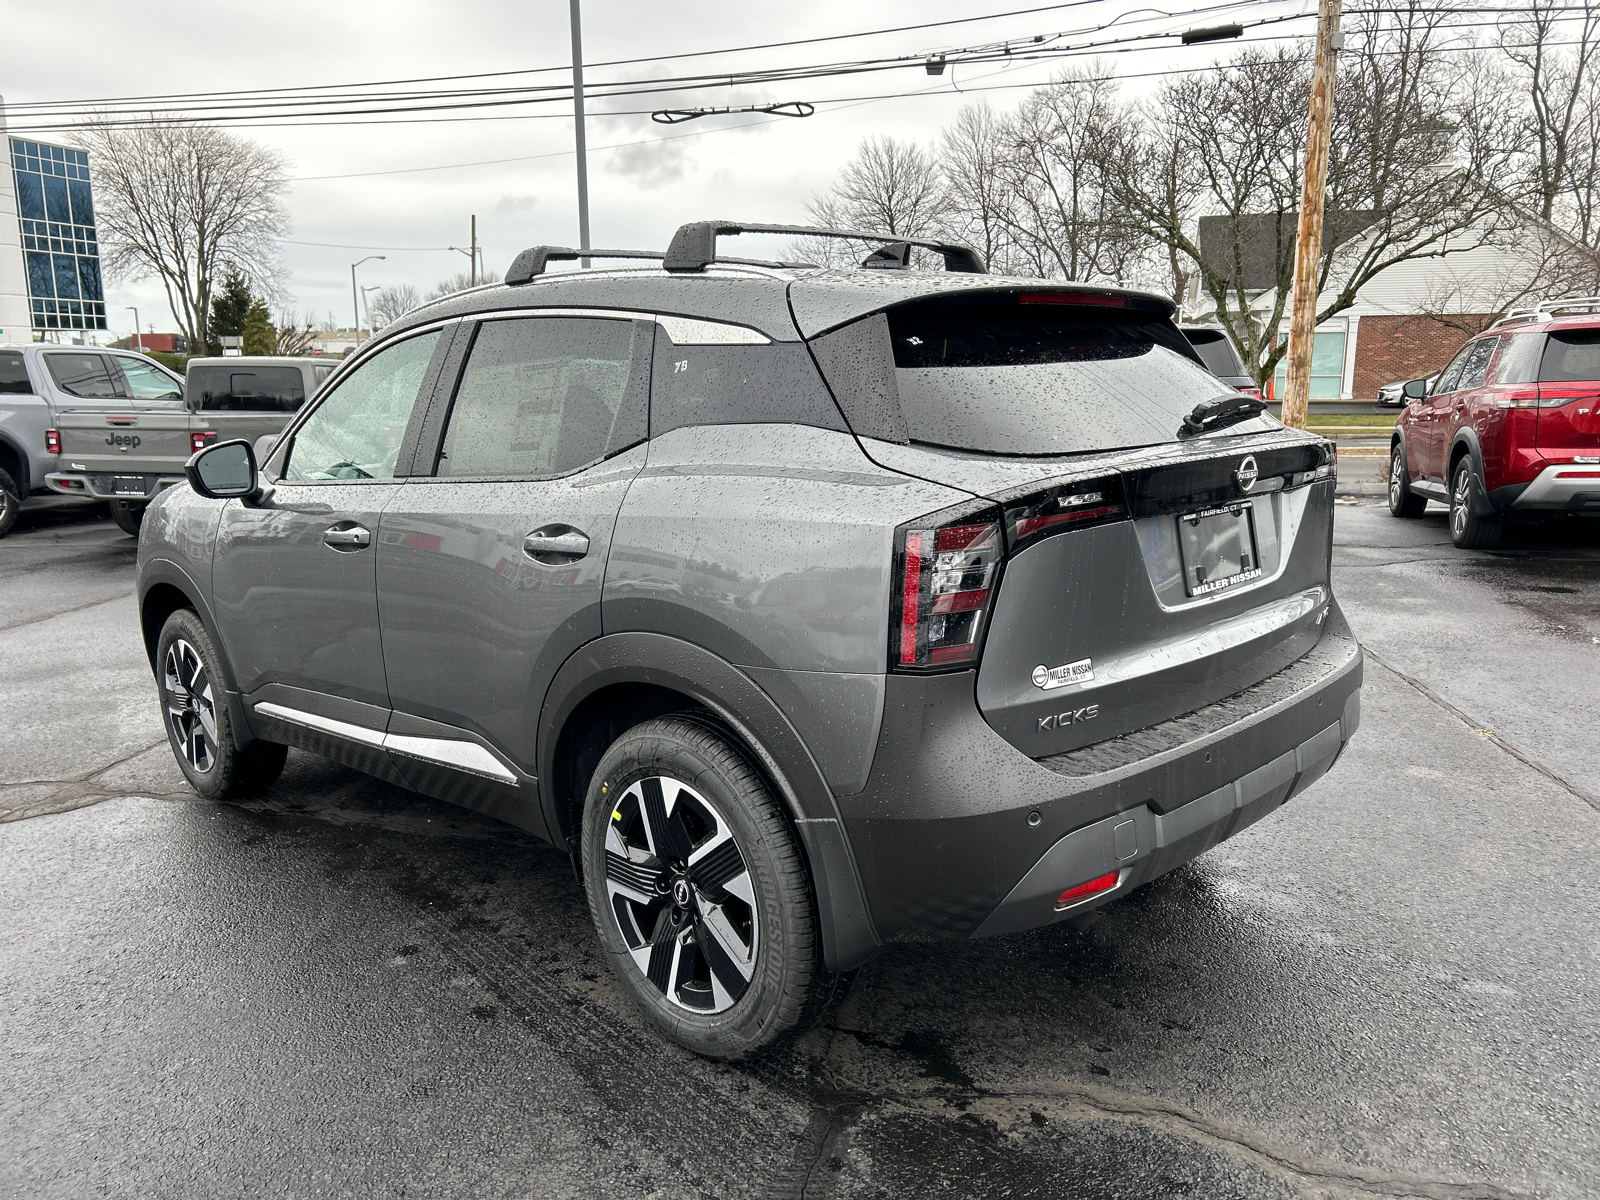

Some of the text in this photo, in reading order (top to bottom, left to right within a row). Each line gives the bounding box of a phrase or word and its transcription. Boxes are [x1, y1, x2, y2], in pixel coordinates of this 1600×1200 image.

[105, 432, 141, 448] Jeep
[1192, 568, 1262, 596] MILLER NISSAN
[1049, 663, 1092, 681] MILLER NISSAN
[1036, 704, 1099, 733] KICKS
[748, 842, 784, 995] BRIDGESTONE
